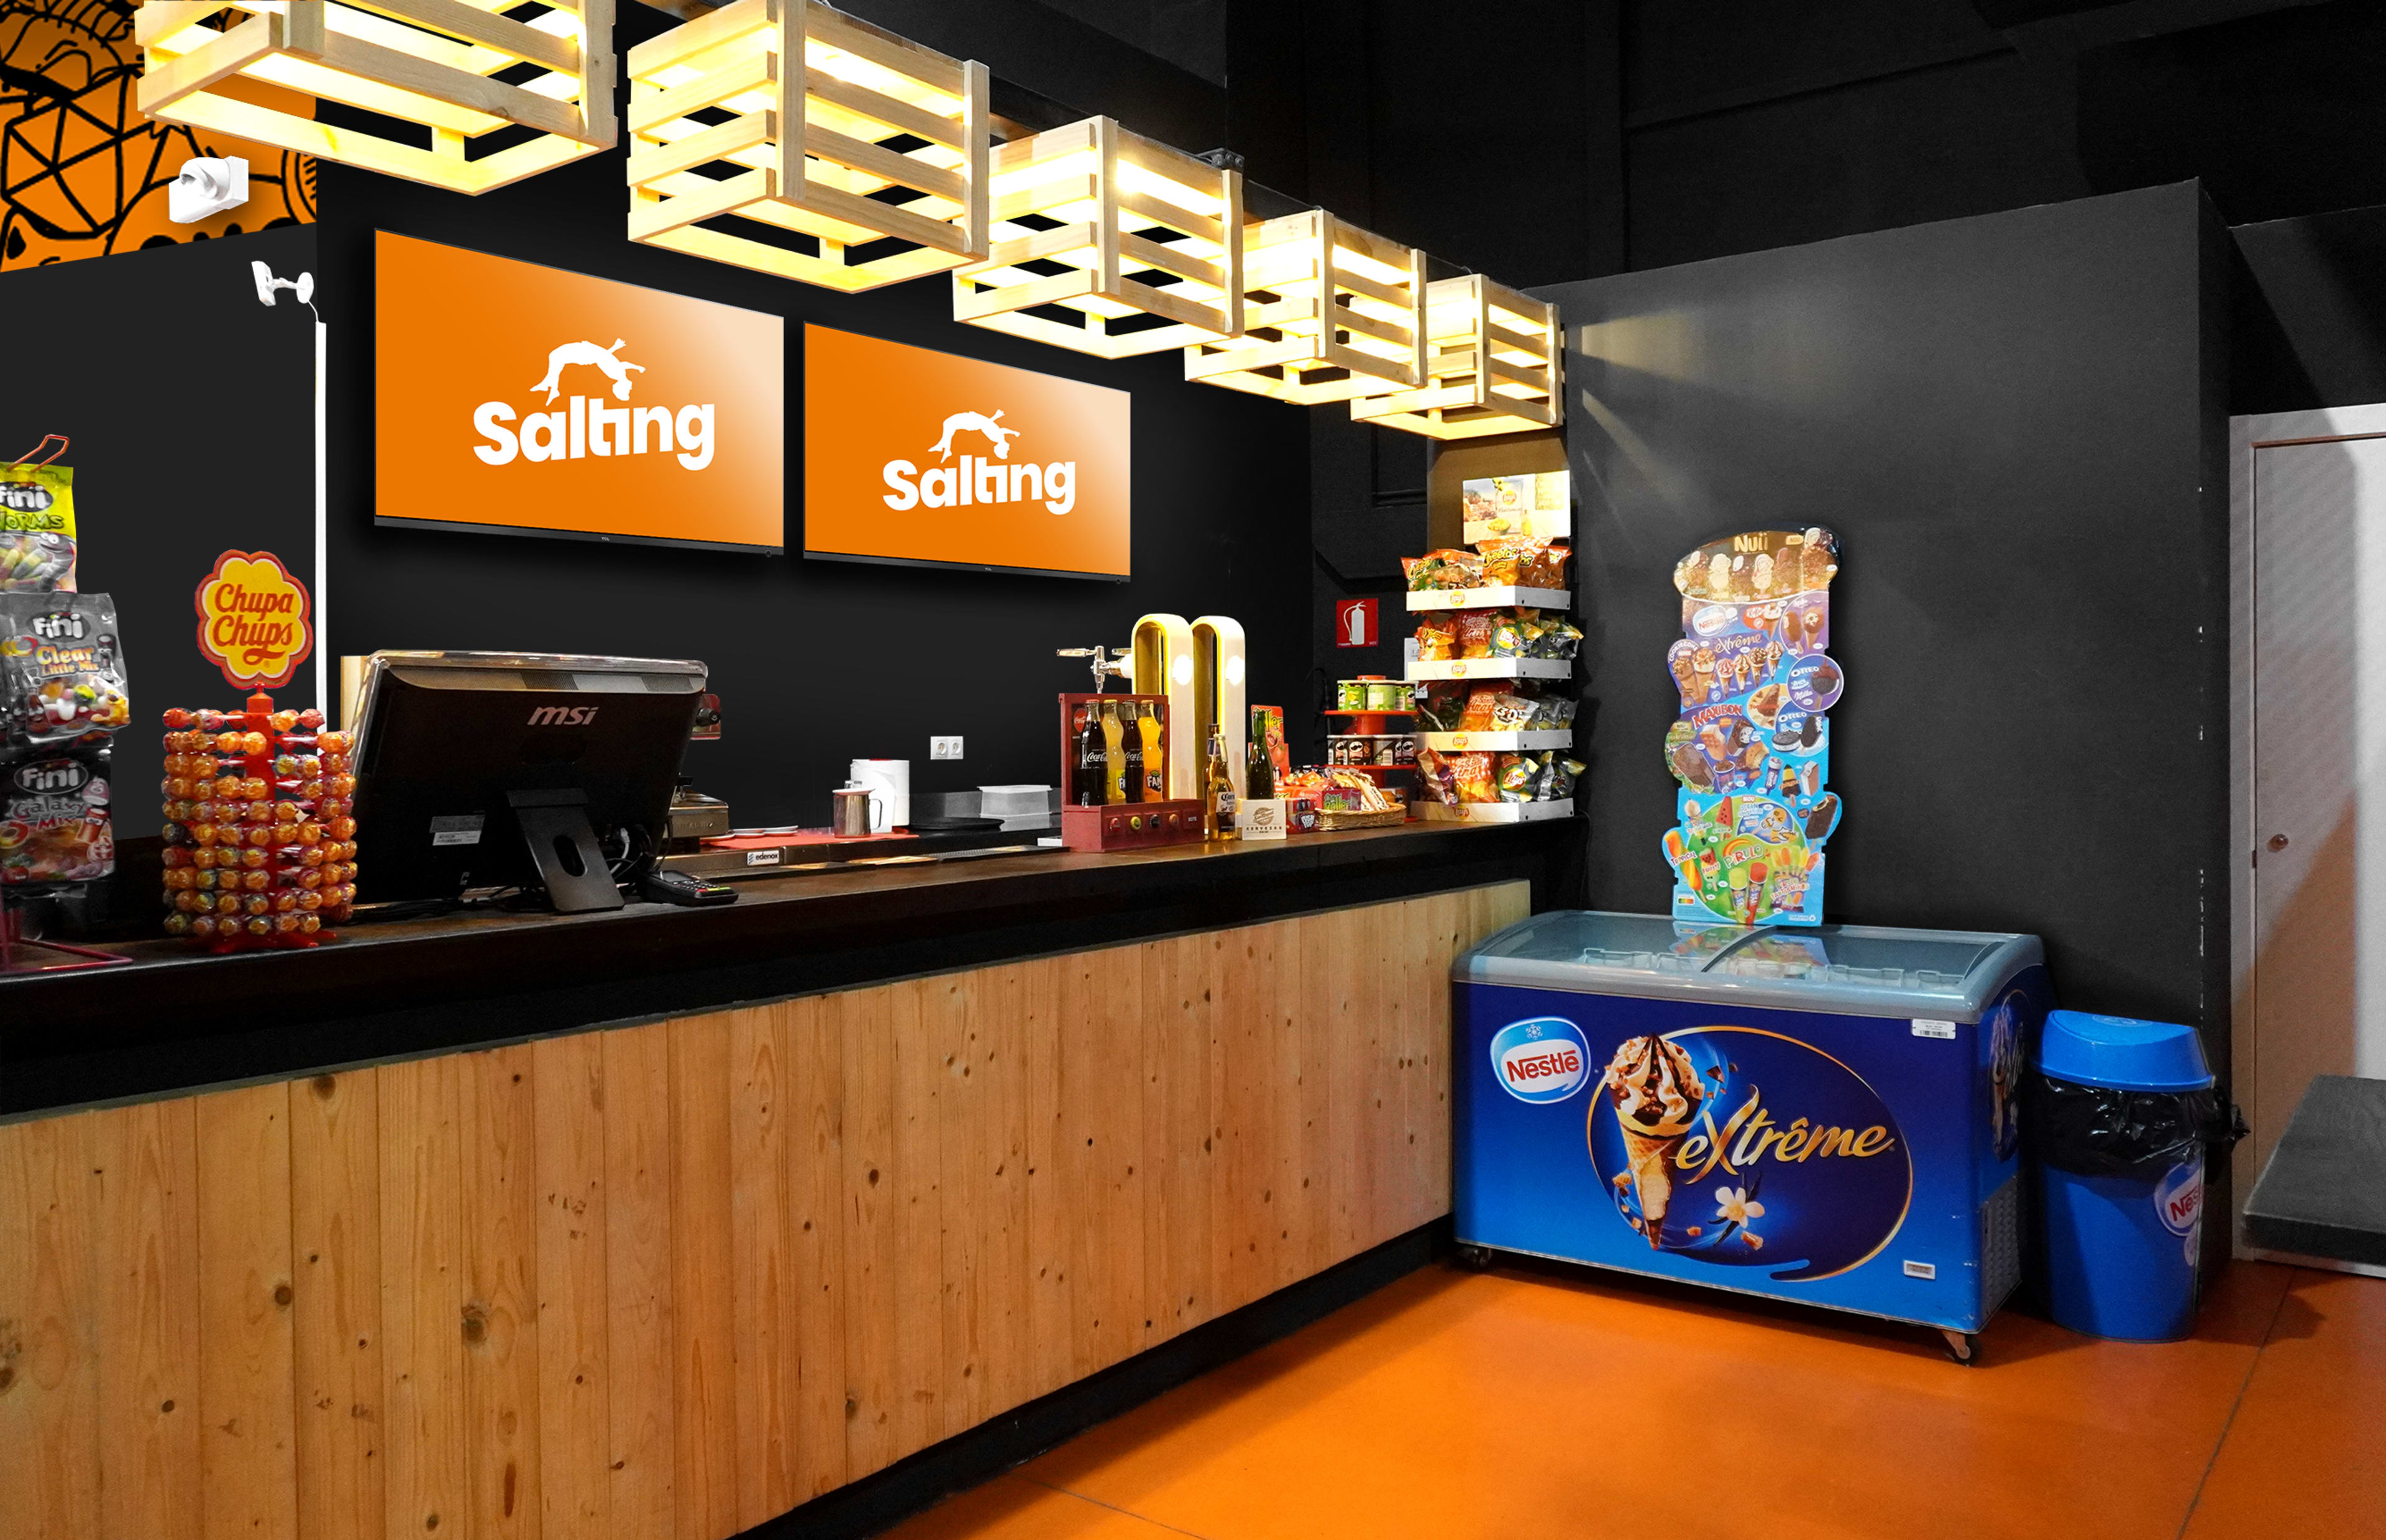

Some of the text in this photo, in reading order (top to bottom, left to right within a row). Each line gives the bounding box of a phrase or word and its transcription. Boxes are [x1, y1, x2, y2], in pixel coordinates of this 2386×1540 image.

[472, 394, 715, 472] Salting
[882, 454, 1076, 516] Salting
[214, 583, 294, 621] Chupa
[33, 613, 83, 639] Fini
[213, 616, 293, 653] Chups
[36, 645, 94, 665] Clear
[1791, 666, 1819, 677] OREO
[527, 706, 601, 726] msi
[1692, 704, 1742, 730] MAXIBON
[1778, 711, 1808, 722] OREO
[22, 762, 78, 790] Fini
[14, 796, 84, 818] Galaxy
[755, 852, 778, 860] edenox
[1506, 1049, 1580, 1082] Nestlé
